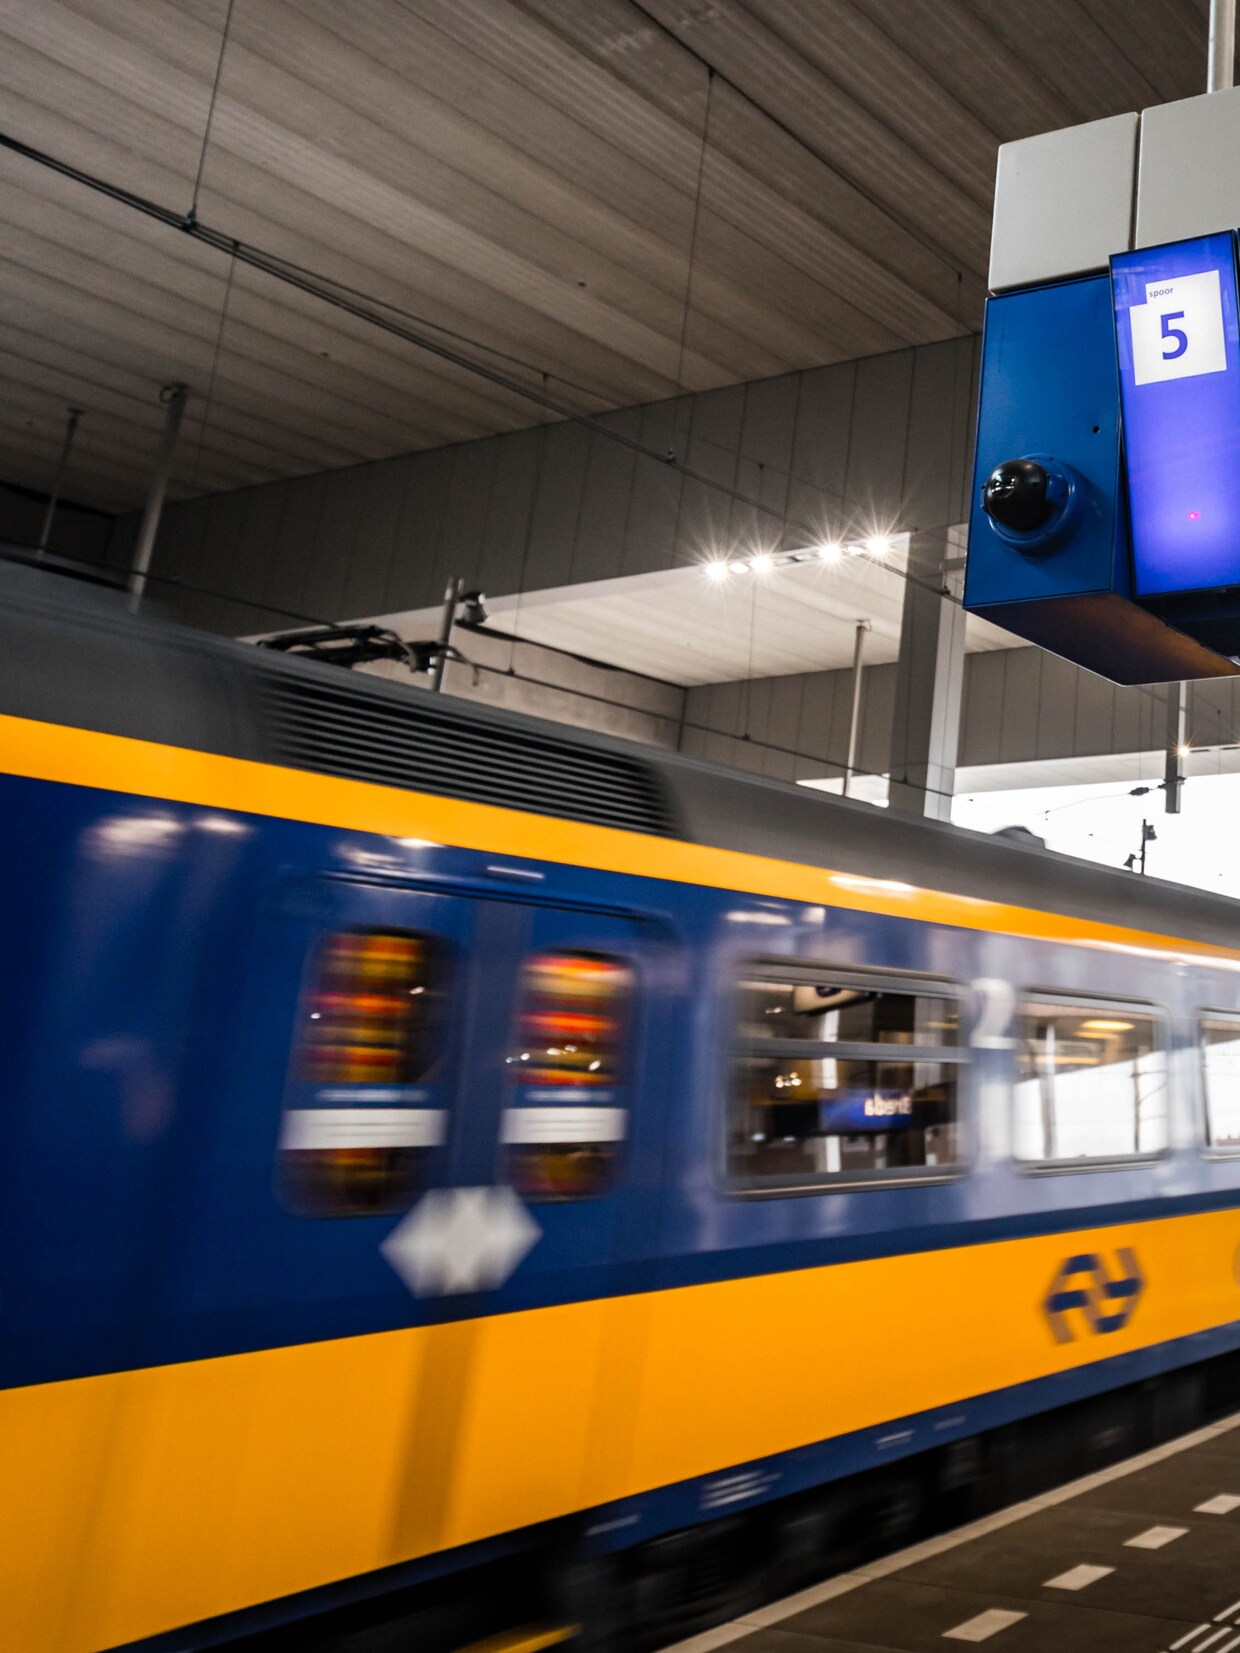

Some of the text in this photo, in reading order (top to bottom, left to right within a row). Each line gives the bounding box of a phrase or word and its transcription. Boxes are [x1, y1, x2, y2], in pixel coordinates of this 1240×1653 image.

[1148, 287, 1174, 299] spoor
[1160, 310, 1188, 360] 5
[969, 977, 1017, 1050] 2
